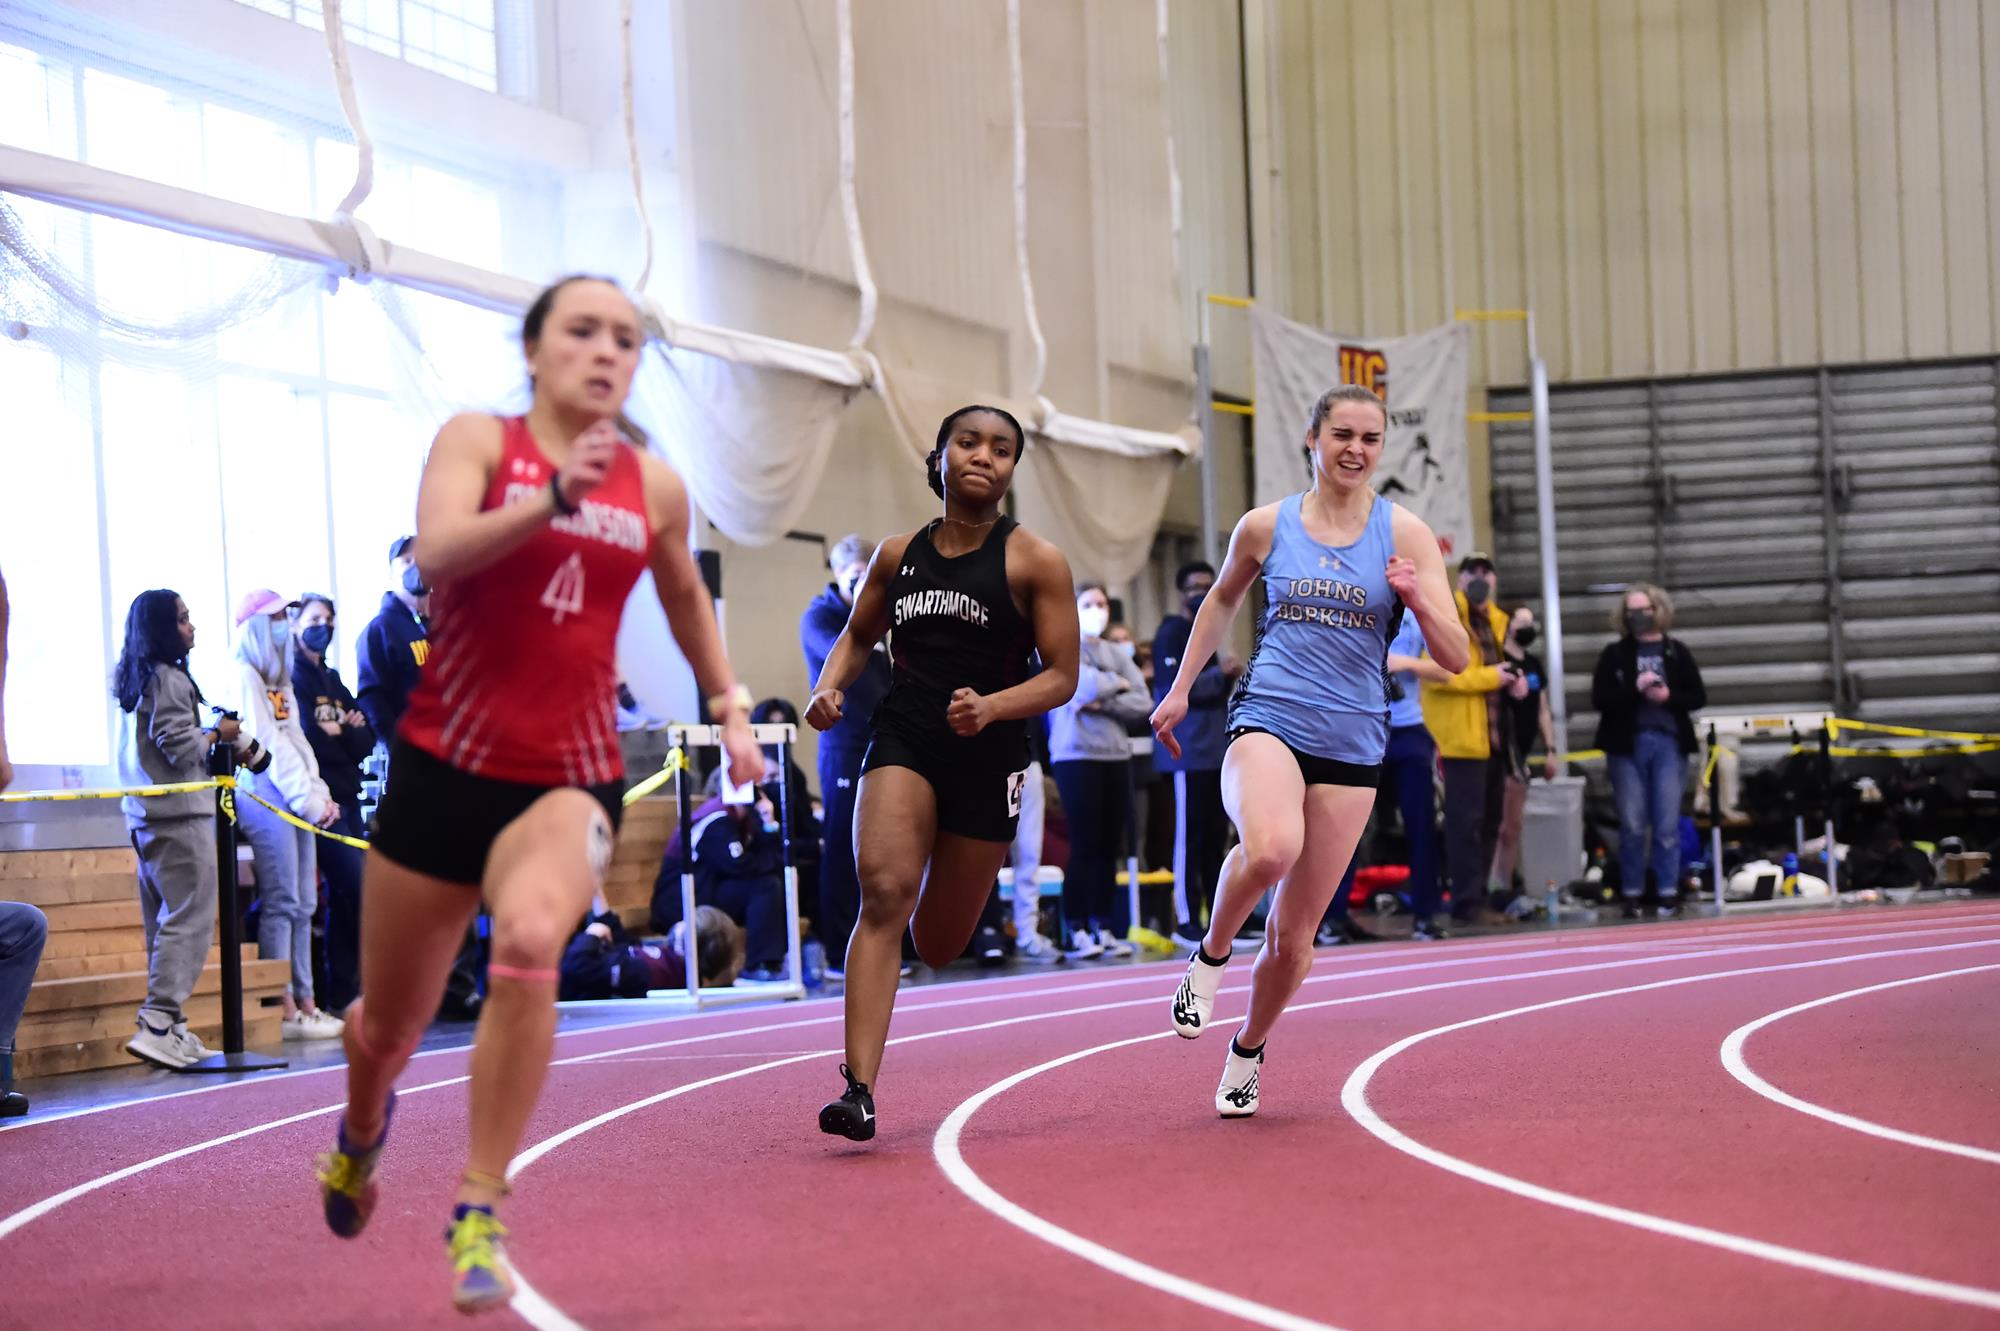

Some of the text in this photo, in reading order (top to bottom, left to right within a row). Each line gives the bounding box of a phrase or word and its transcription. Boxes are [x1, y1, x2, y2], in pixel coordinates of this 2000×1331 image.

[540, 551, 586, 625] 4
[1288, 577, 1367, 608] JOHNS
[895, 589, 990, 629] SWARTHMORE
[1276, 602, 1377, 631] HOPKINS
